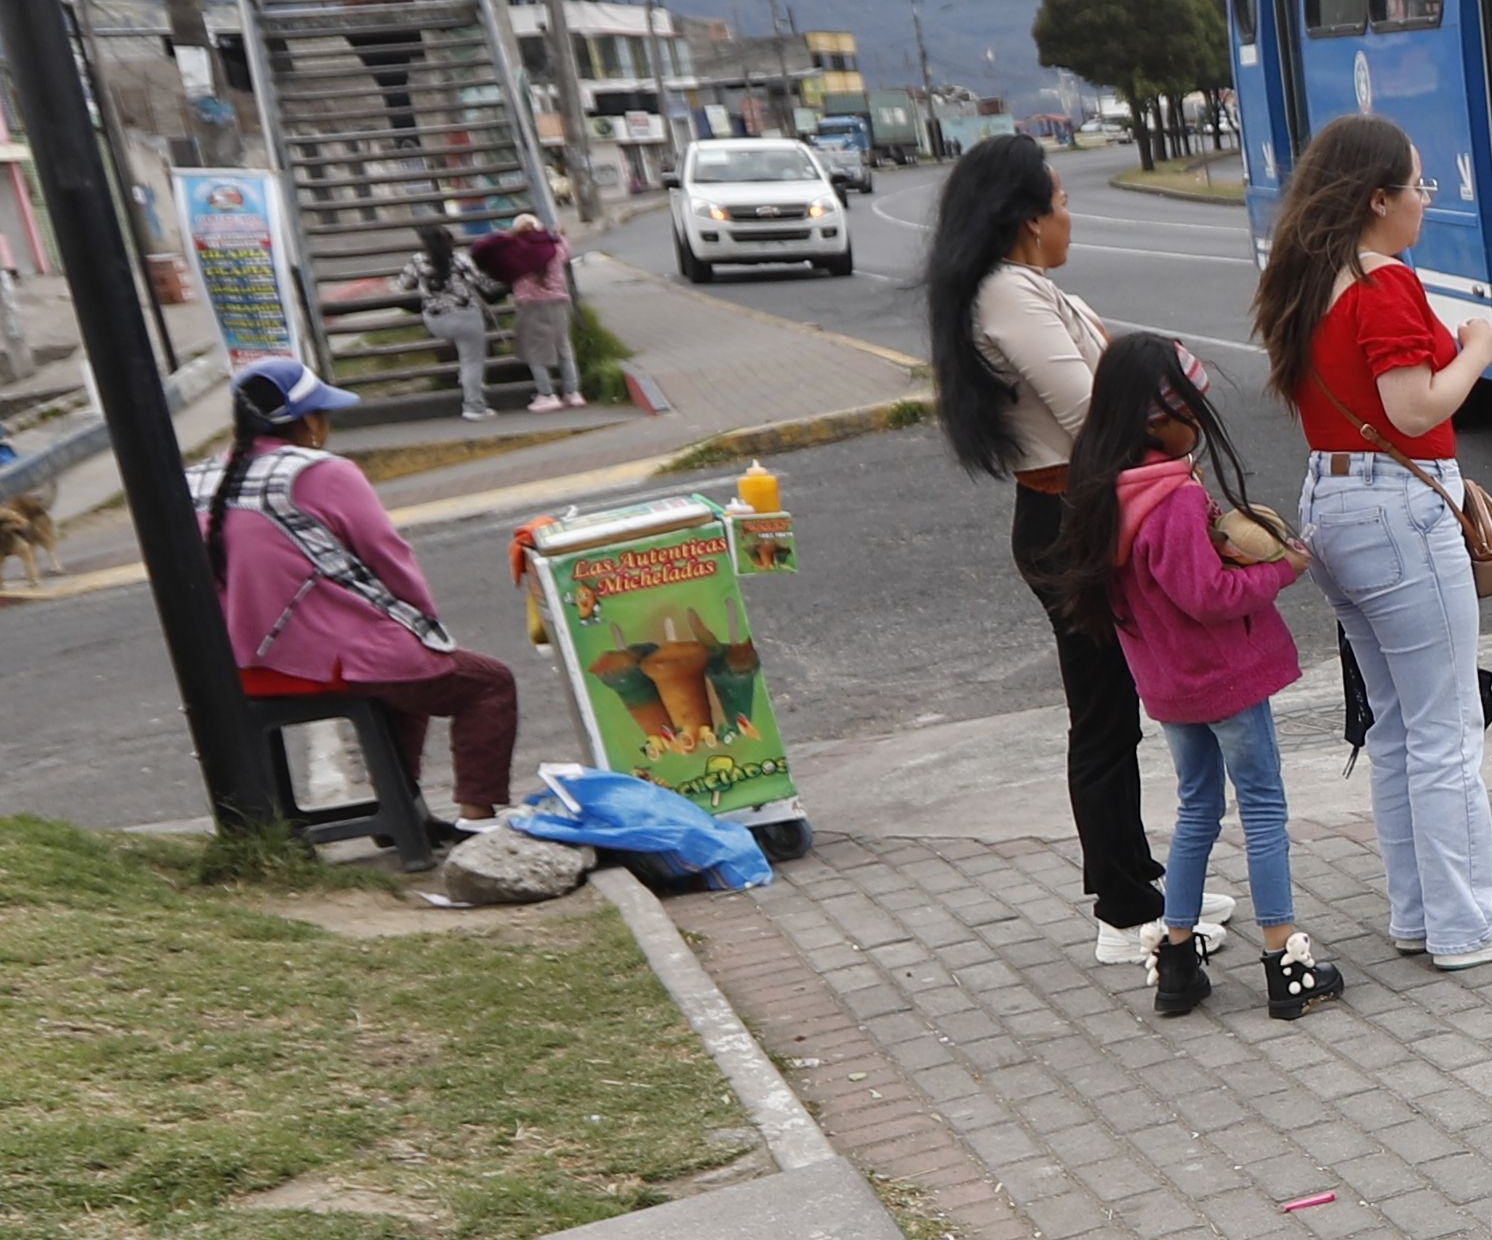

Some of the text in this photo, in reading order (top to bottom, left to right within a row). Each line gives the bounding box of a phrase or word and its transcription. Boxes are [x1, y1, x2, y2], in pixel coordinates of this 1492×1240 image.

[573, 537, 727, 579] Las Autenticas
[597, 560, 717, 597] Micheladas
